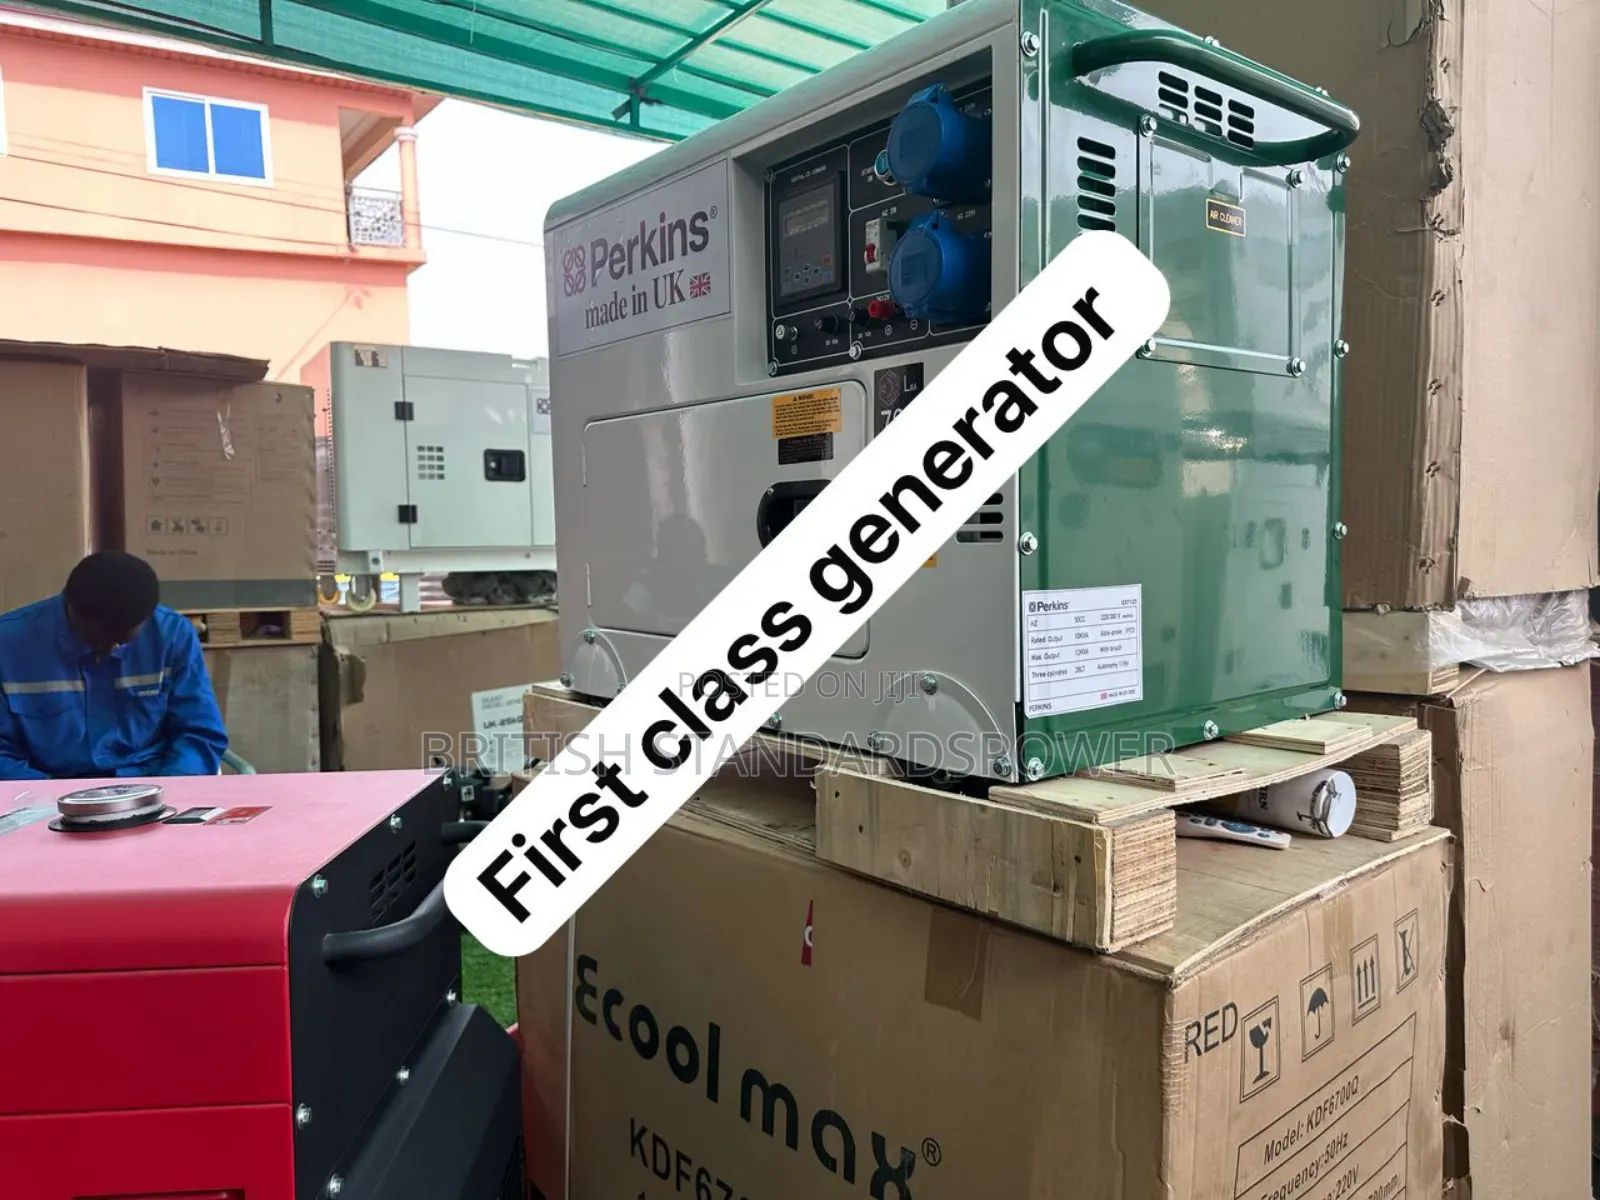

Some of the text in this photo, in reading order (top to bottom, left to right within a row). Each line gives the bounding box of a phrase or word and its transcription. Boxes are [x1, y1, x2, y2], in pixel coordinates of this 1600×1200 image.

[586, 269, 686, 329] made in UK
[575, 954, 721, 1104] Ecool
[630, 1117, 749, 1200] KDF67
[1263, 1075, 1360, 1165] Model: KDF6700Q
